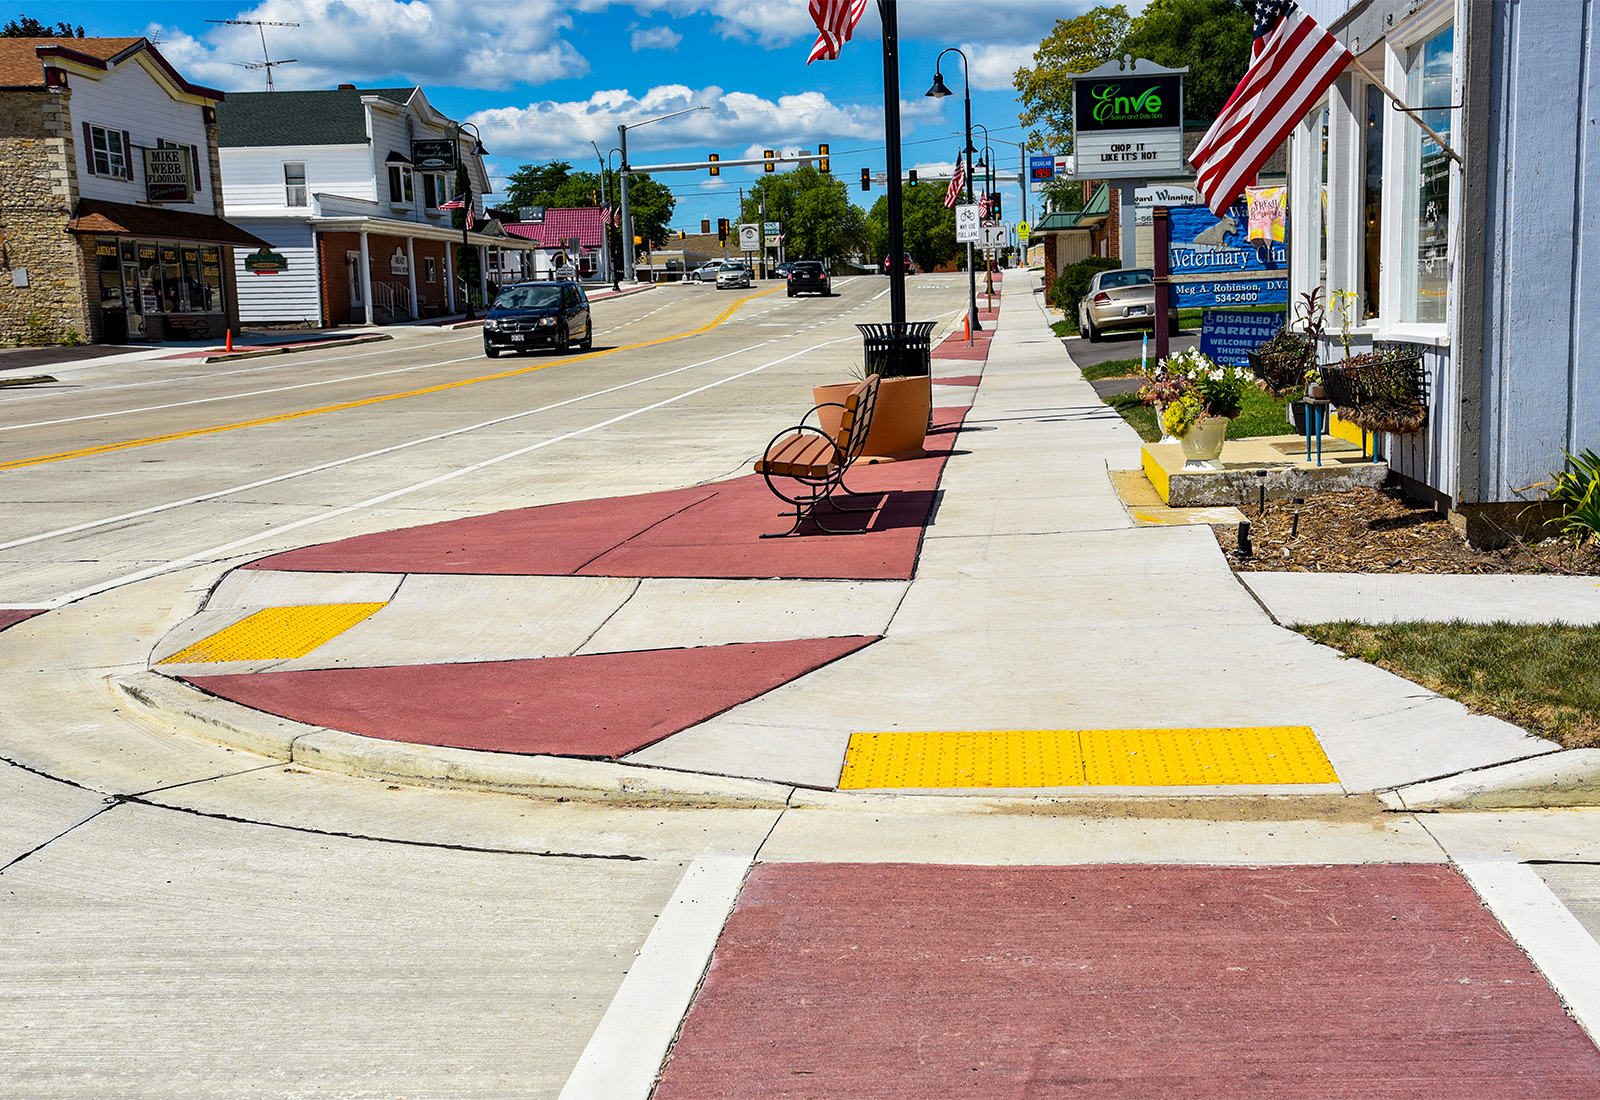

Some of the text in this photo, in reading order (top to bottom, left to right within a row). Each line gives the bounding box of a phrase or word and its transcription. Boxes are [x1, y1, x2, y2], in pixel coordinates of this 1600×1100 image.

[1091, 83, 1163, 125] Enve
[1110, 143, 1144, 152] CHOP IT
[152, 151, 179, 162] MIKE
[1101, 152, 1158, 162] LIKE IT'S HOT
[150, 163, 182, 174] WEBB
[148, 174, 186, 184] FLOORING
[1155, 189, 1194, 202] Winning
[1254, 199, 1278, 210] FRESH
[1173, 244, 1288, 269] Veterinary Clin
[1176, 286, 1195, 295] Meg
[1200, 284, 1210, 293] A.
[1214, 283, 1260, 292] Robinson,
[1215, 293, 1258, 303] 534-2400
[1216, 315, 1271, 324] DISABLED
[1210, 338, 1253, 346] WELCOME
